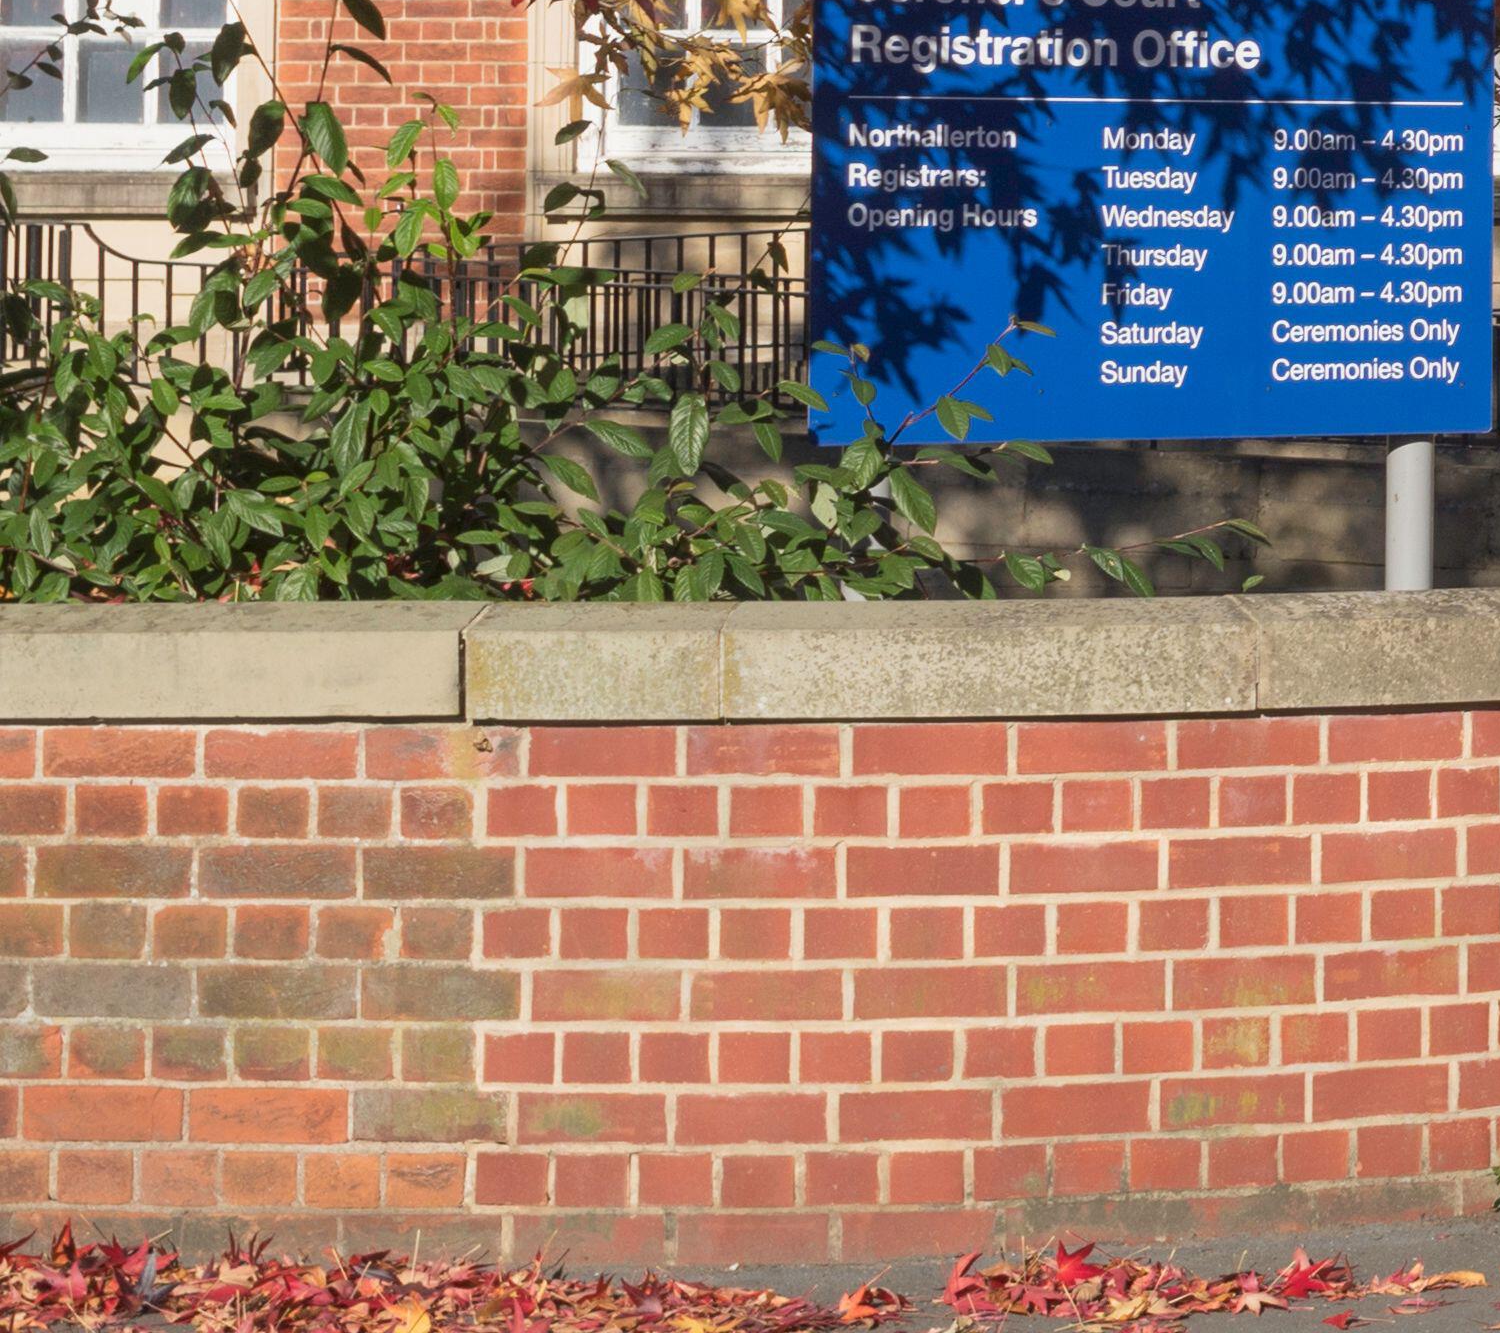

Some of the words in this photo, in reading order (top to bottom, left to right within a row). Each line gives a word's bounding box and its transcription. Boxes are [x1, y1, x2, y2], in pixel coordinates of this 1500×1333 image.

[851, 24, 1118, 74] Registration
[1132, 29, 1261, 70] Office
[848, 123, 1018, 149] Northallerton
[1102, 127, 1197, 157] Monday
[1273, 129, 1356, 151] 9.00am
[1381, 129, 1465, 157] 4.30pm
[847, 163, 987, 193] Registrars:
[1102, 165, 1198, 195] Tuesday
[1273, 167, 1356, 189] 9.00am
[1381, 167, 1464, 195] 4.30pm
[847, 203, 954, 232] Opening
[962, 203, 1038, 228] Hours
[1101, 204, 1236, 234] Wednesday
[1272, 205, 1356, 228] 9.00am
[1380, 205, 1464, 233] 4.30pm
[1101, 243, 1209, 272] Thursday
[1272, 243, 1356, 266] 9.00am
[1380, 243, 1463, 271] 4.30pm
[1101, 283, 1173, 311] Friday
[1271, 282, 1355, 304] 9.00am
[1379, 281, 1463, 309] 4.30pm
[1101, 321, 1204, 350] Saturday
[1271, 319, 1404, 343] Ceremonies
[1409, 318, 1461, 347] Only
[1100, 360, 1189, 389] Sunday
[1271, 357, 1404, 381] Ceremonies
[1409, 356, 1461, 384] Only
